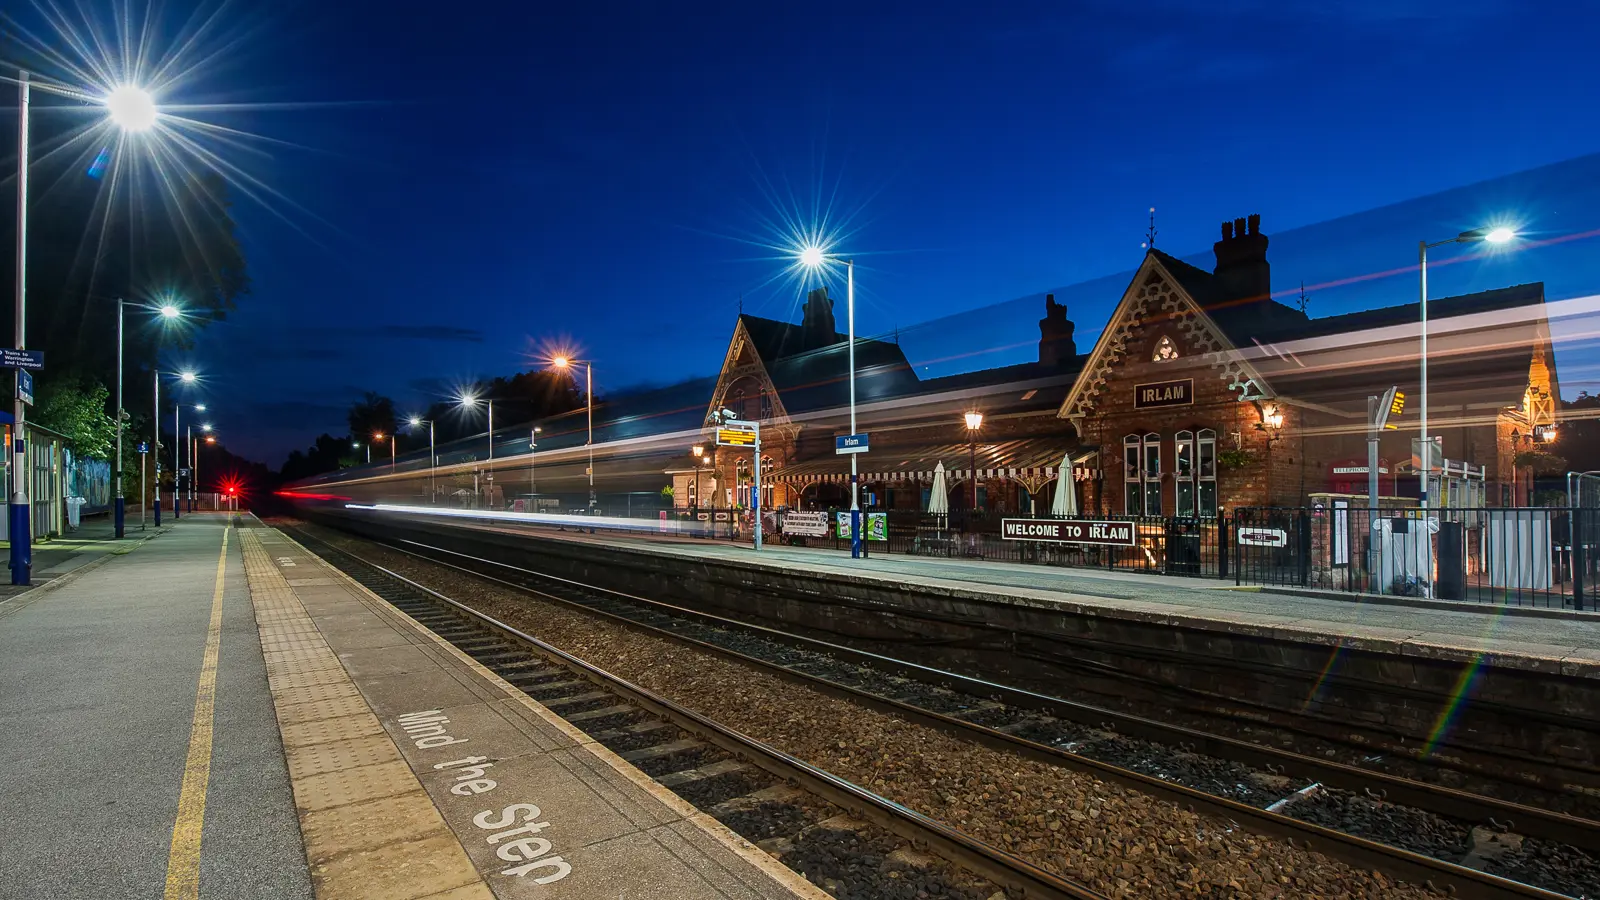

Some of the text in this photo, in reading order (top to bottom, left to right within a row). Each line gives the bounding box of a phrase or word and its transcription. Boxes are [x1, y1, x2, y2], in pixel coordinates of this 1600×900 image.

[1142, 385, 1184, 402] IRLAM
[844, 438, 859, 446] Irlam
[1006, 523, 1129, 540] WELCOME TO IRLAM
[398, 709, 572, 885] Mind the Step
